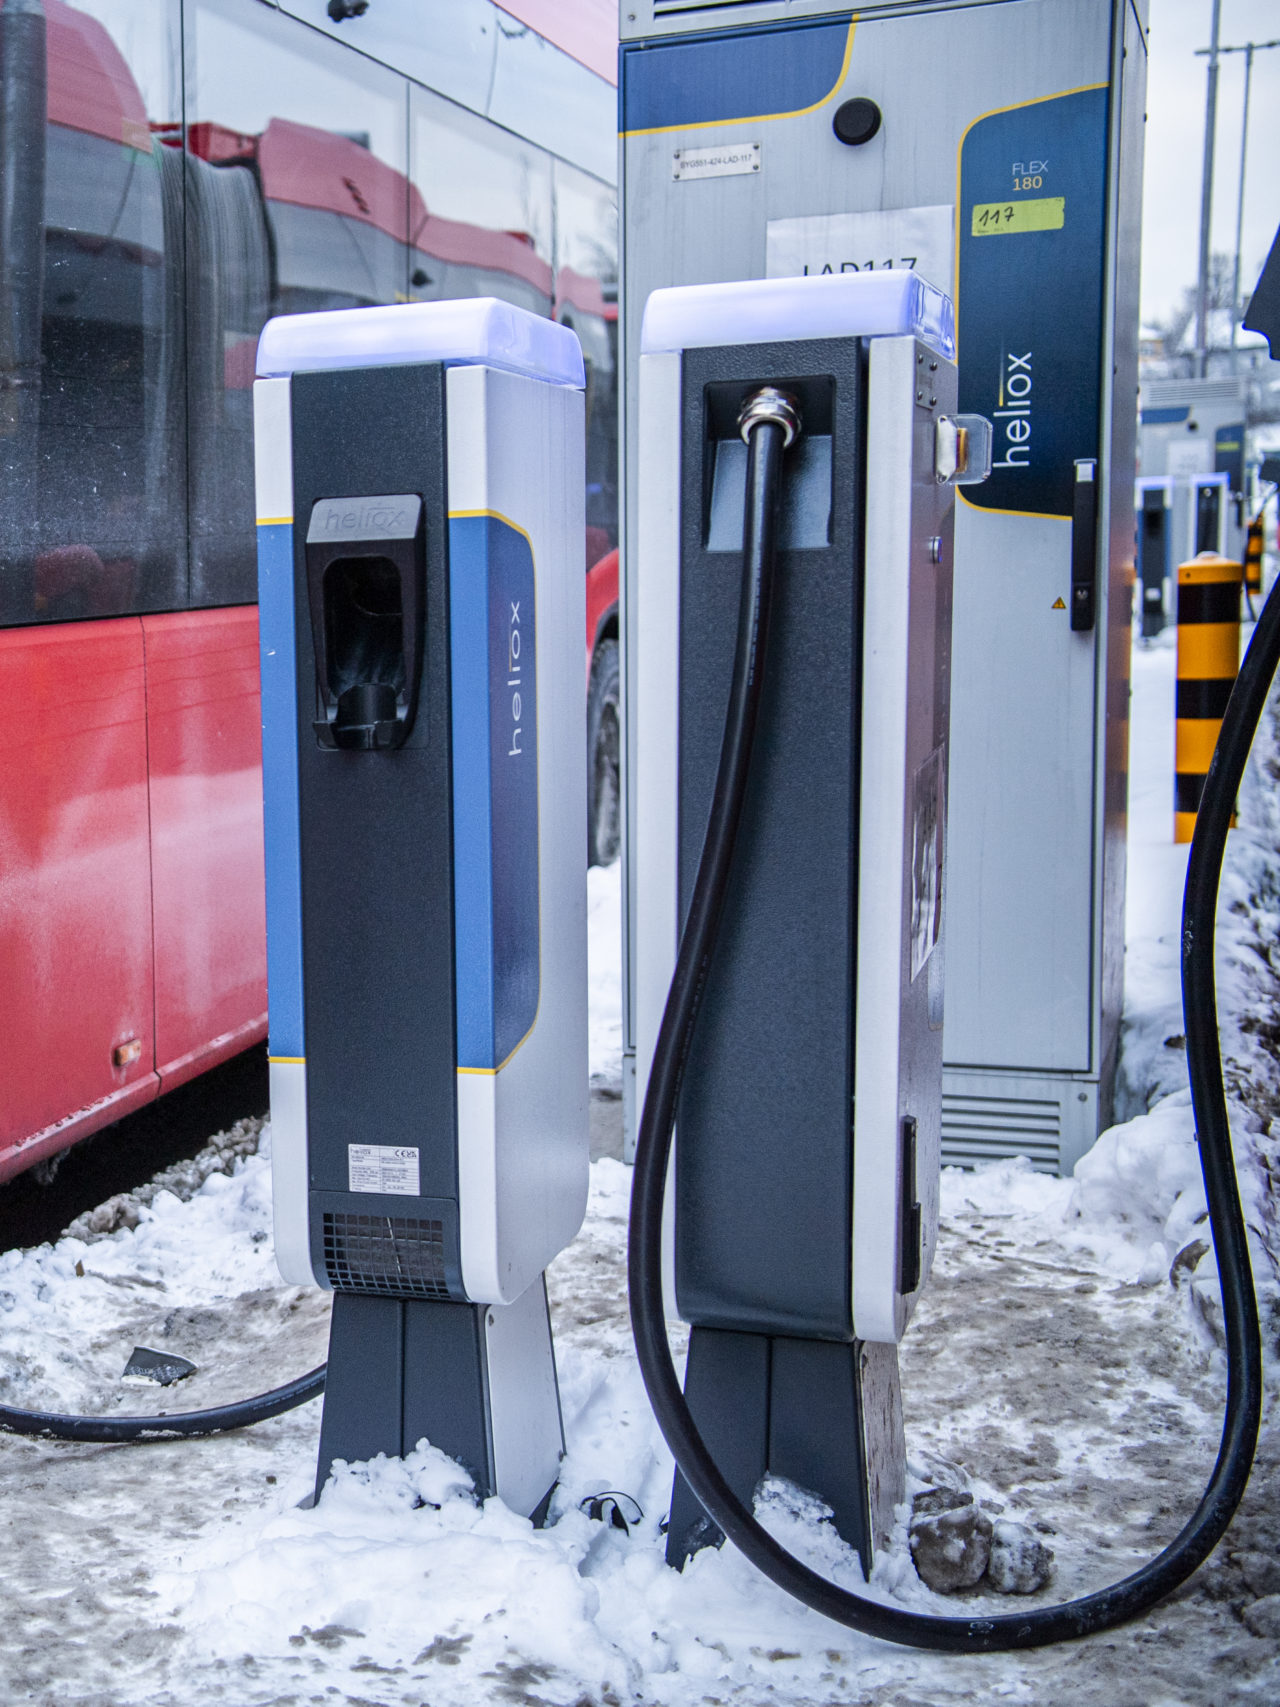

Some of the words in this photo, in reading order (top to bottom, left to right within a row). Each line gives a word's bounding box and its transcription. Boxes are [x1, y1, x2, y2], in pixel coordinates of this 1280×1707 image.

[1012, 160, 1049, 176] FLEX
[1013, 176, 1042, 191] 180
[978, 206, 1015, 227] 117
[993, 351, 1032, 468] heliox
[324, 506, 407, 532] heliox
[507, 601, 522, 756] heliox
